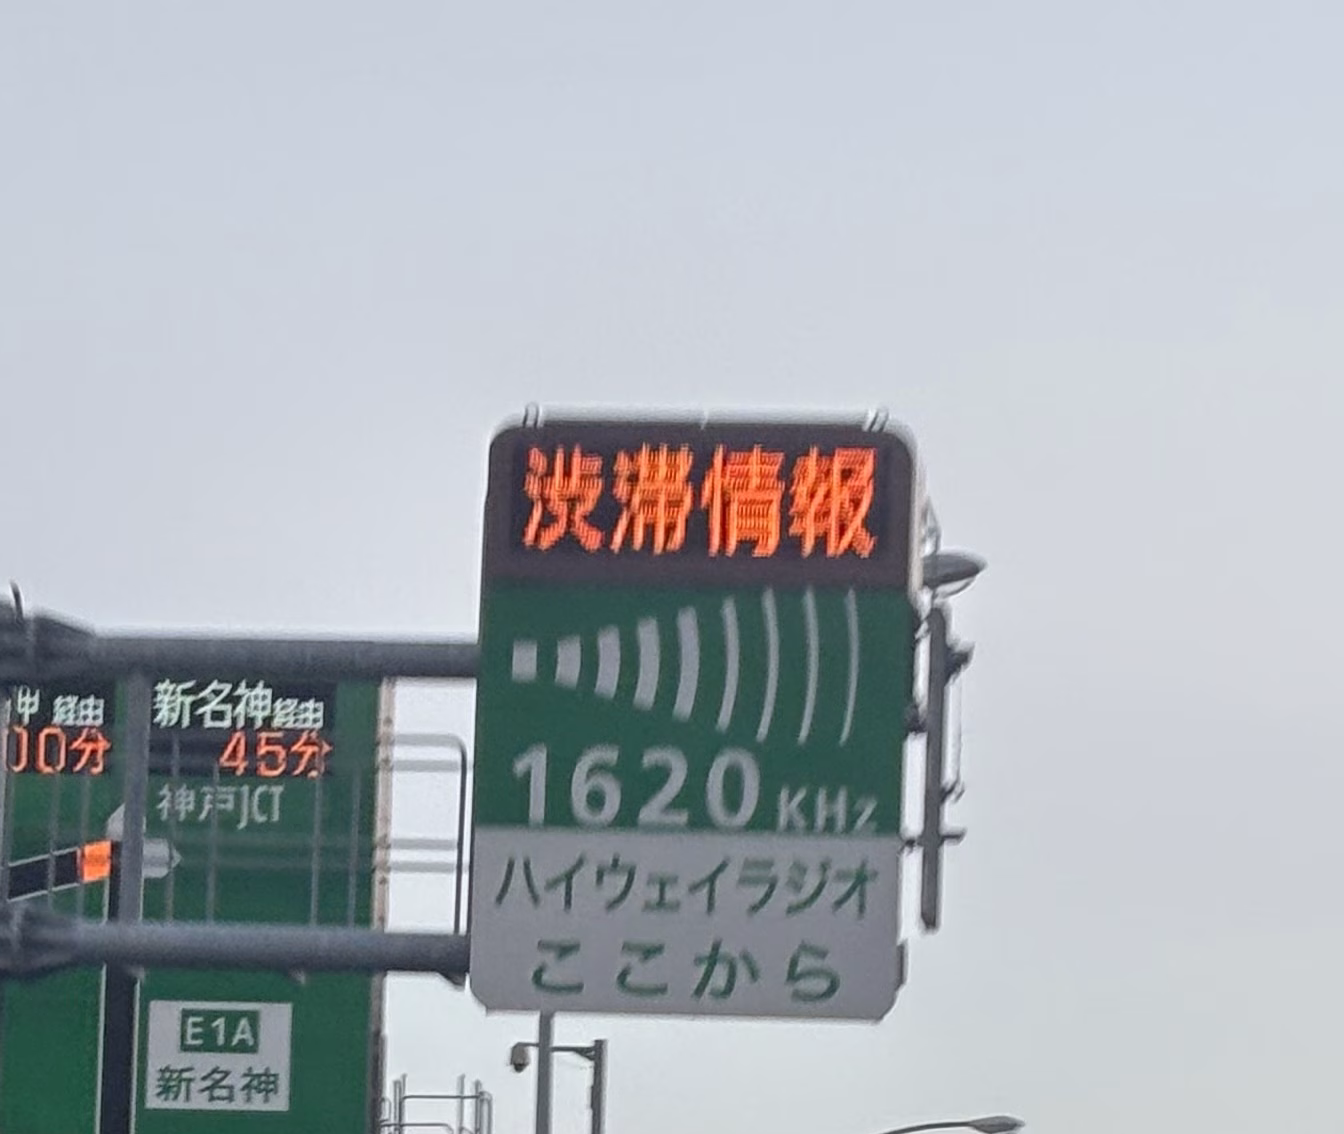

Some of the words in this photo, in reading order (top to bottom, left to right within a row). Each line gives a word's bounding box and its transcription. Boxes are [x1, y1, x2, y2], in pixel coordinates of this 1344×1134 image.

[522, 441, 877, 558] 渋滞情報
[512, 743, 760, 828] 1620
[495, 853, 878, 916] ハイウェイラジオ
[531, 939, 841, 1003] ここから
[183, 1016, 255, 1046] E1A
[156, 1064, 279, 1104] 新名神
